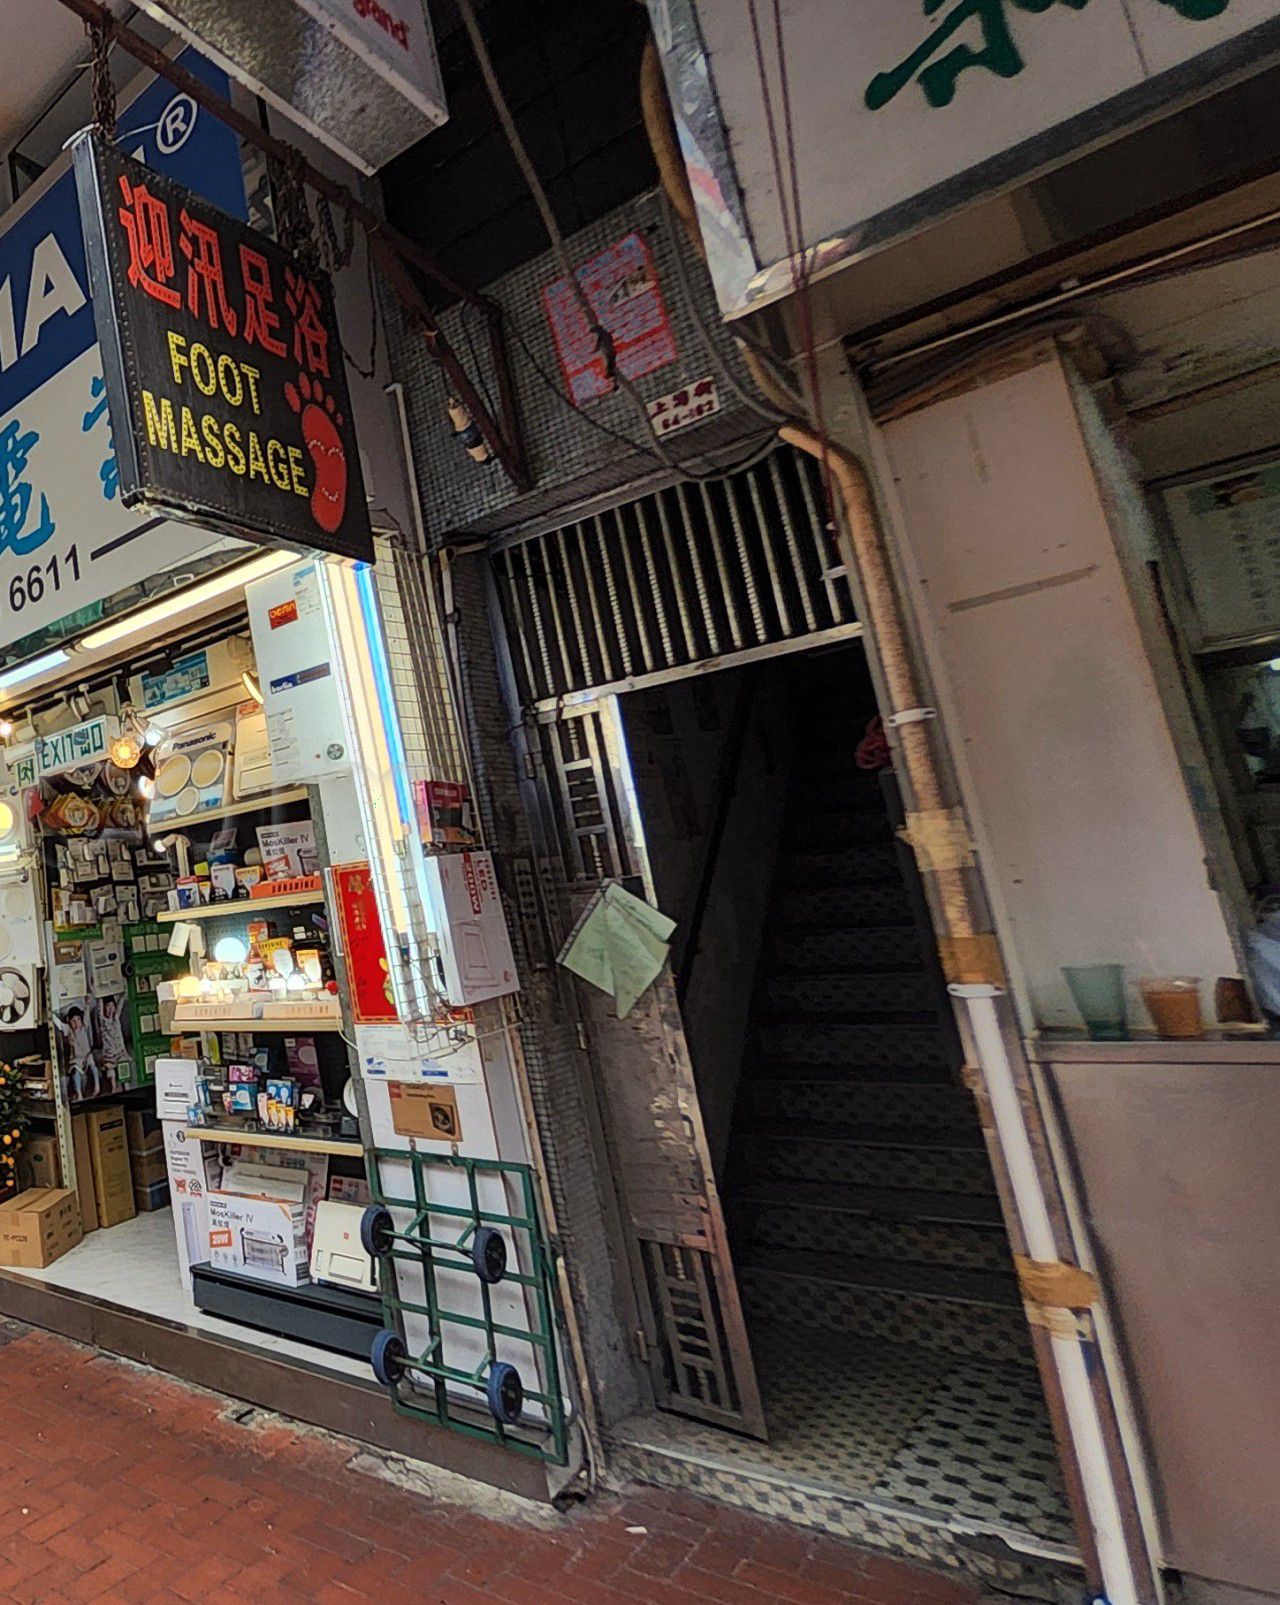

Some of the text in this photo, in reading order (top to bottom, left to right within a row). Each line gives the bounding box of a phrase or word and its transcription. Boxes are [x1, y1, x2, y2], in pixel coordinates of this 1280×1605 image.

[167, 330, 261, 416] FOOT
[141, 390, 310, 497] MASSAGE
[9, 543, 82, 613] 6611
[41, 733, 75, 770] EXIT
[172, 732, 217, 751] Panasonic
